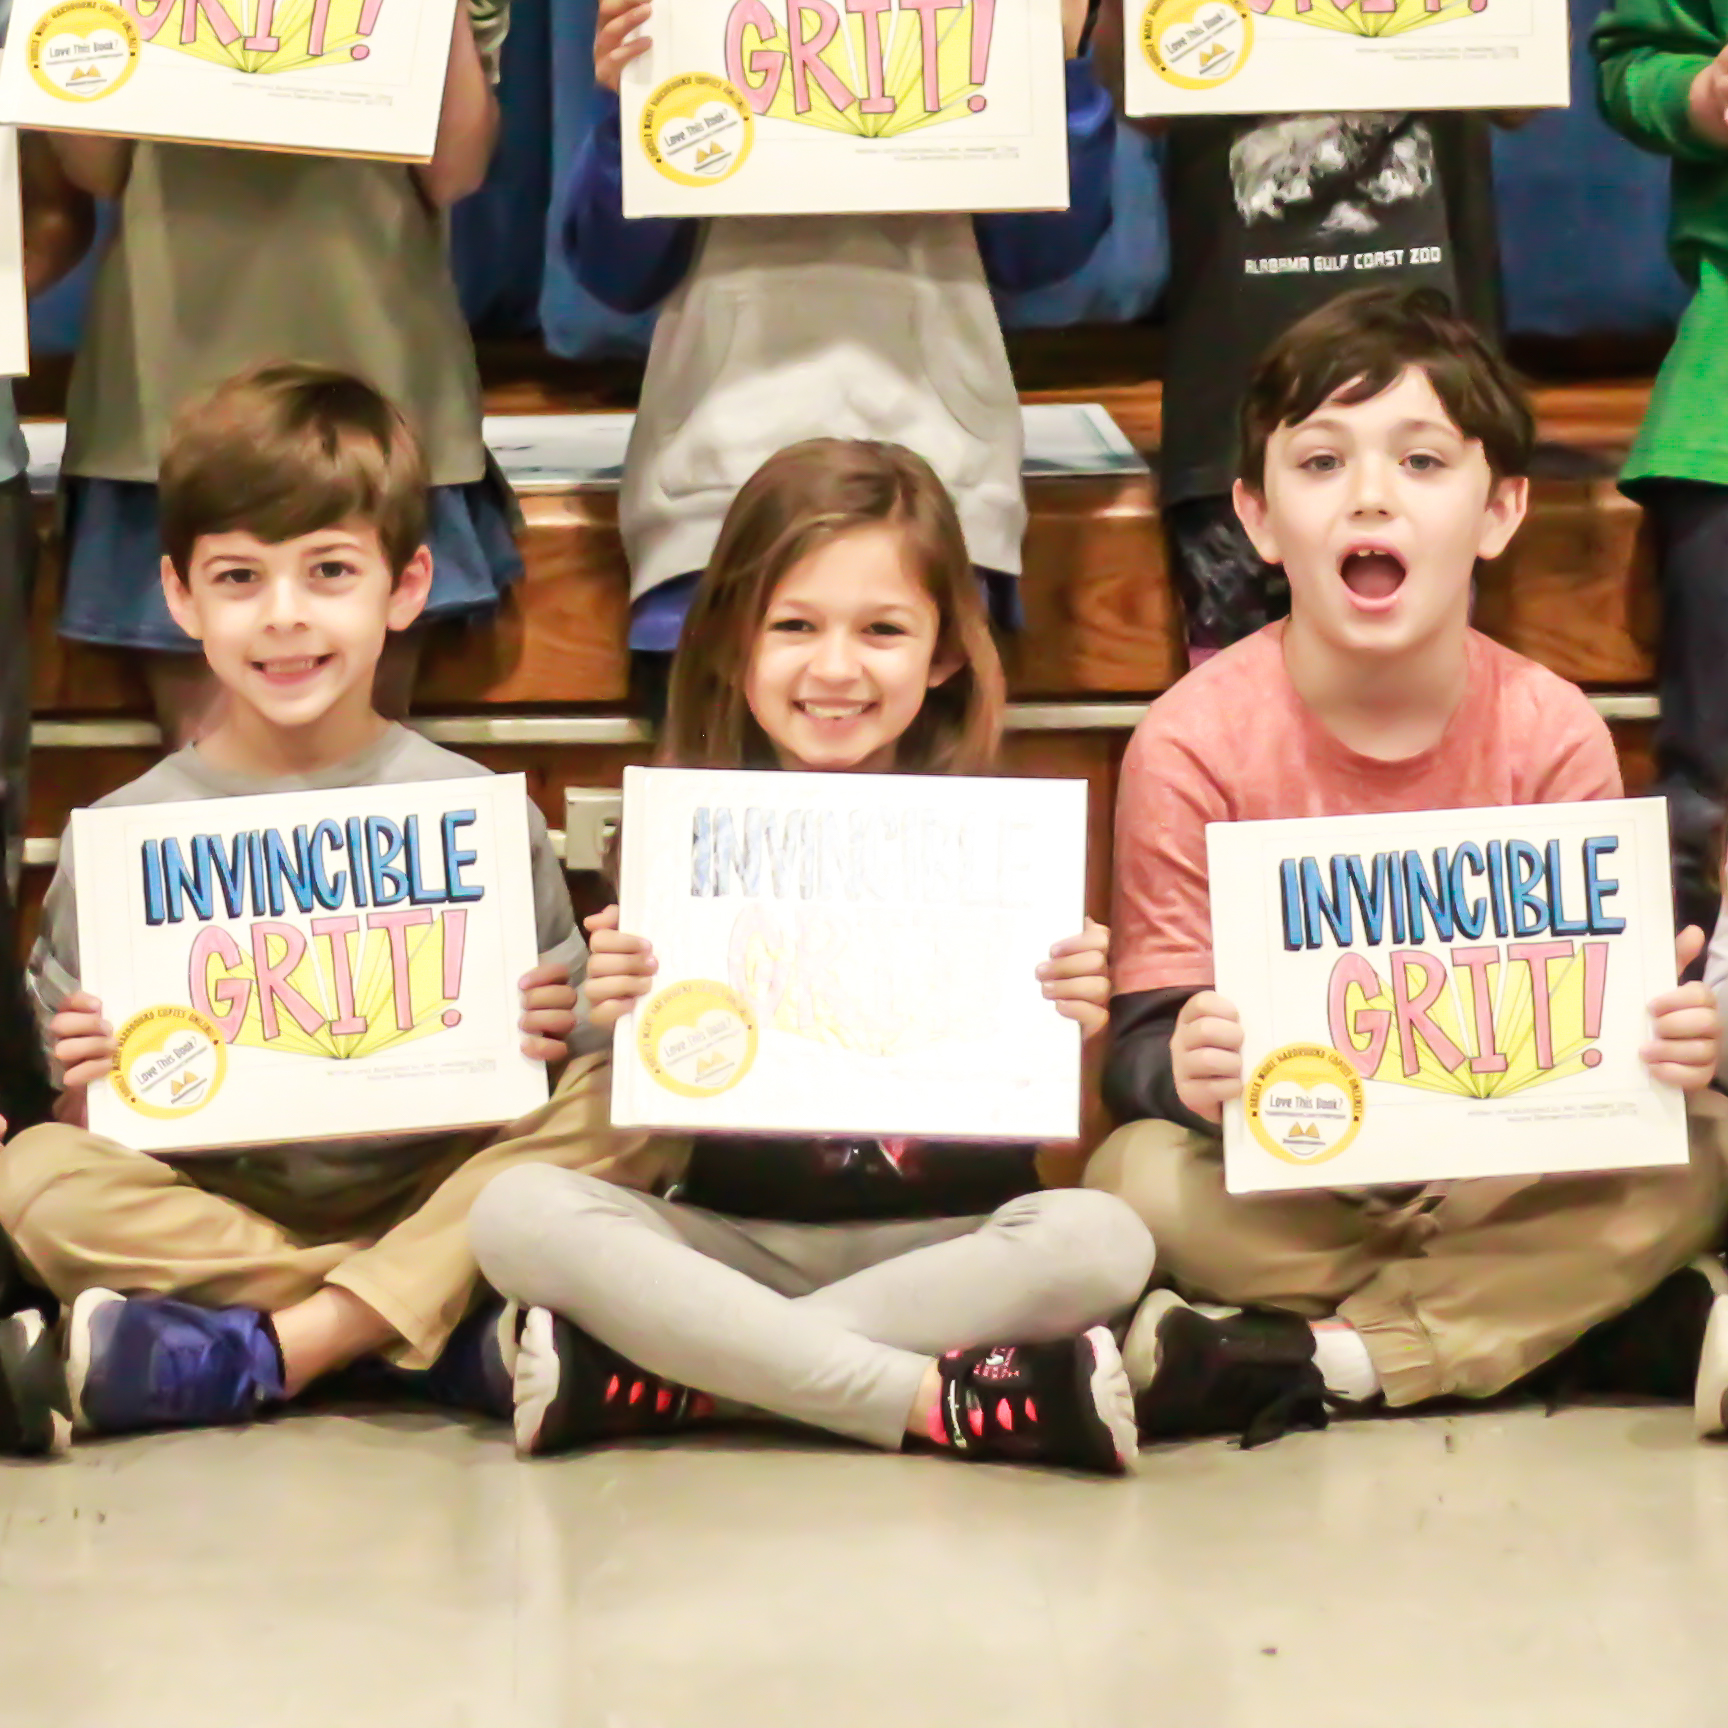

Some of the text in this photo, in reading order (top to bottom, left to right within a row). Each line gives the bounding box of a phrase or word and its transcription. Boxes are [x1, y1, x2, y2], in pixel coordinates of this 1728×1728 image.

[1313, 255, 1349, 272] GULF
[1353, 249, 1404, 270] COAST
[1410, 246, 1442, 265] ZOO
[142, 811, 482, 925] INVINCIBLE
[1281, 837, 1624, 950] INVINCIBLE
[194, 909, 466, 1044] GRIT!
[1330, 940, 1608, 1079] GRIT!
